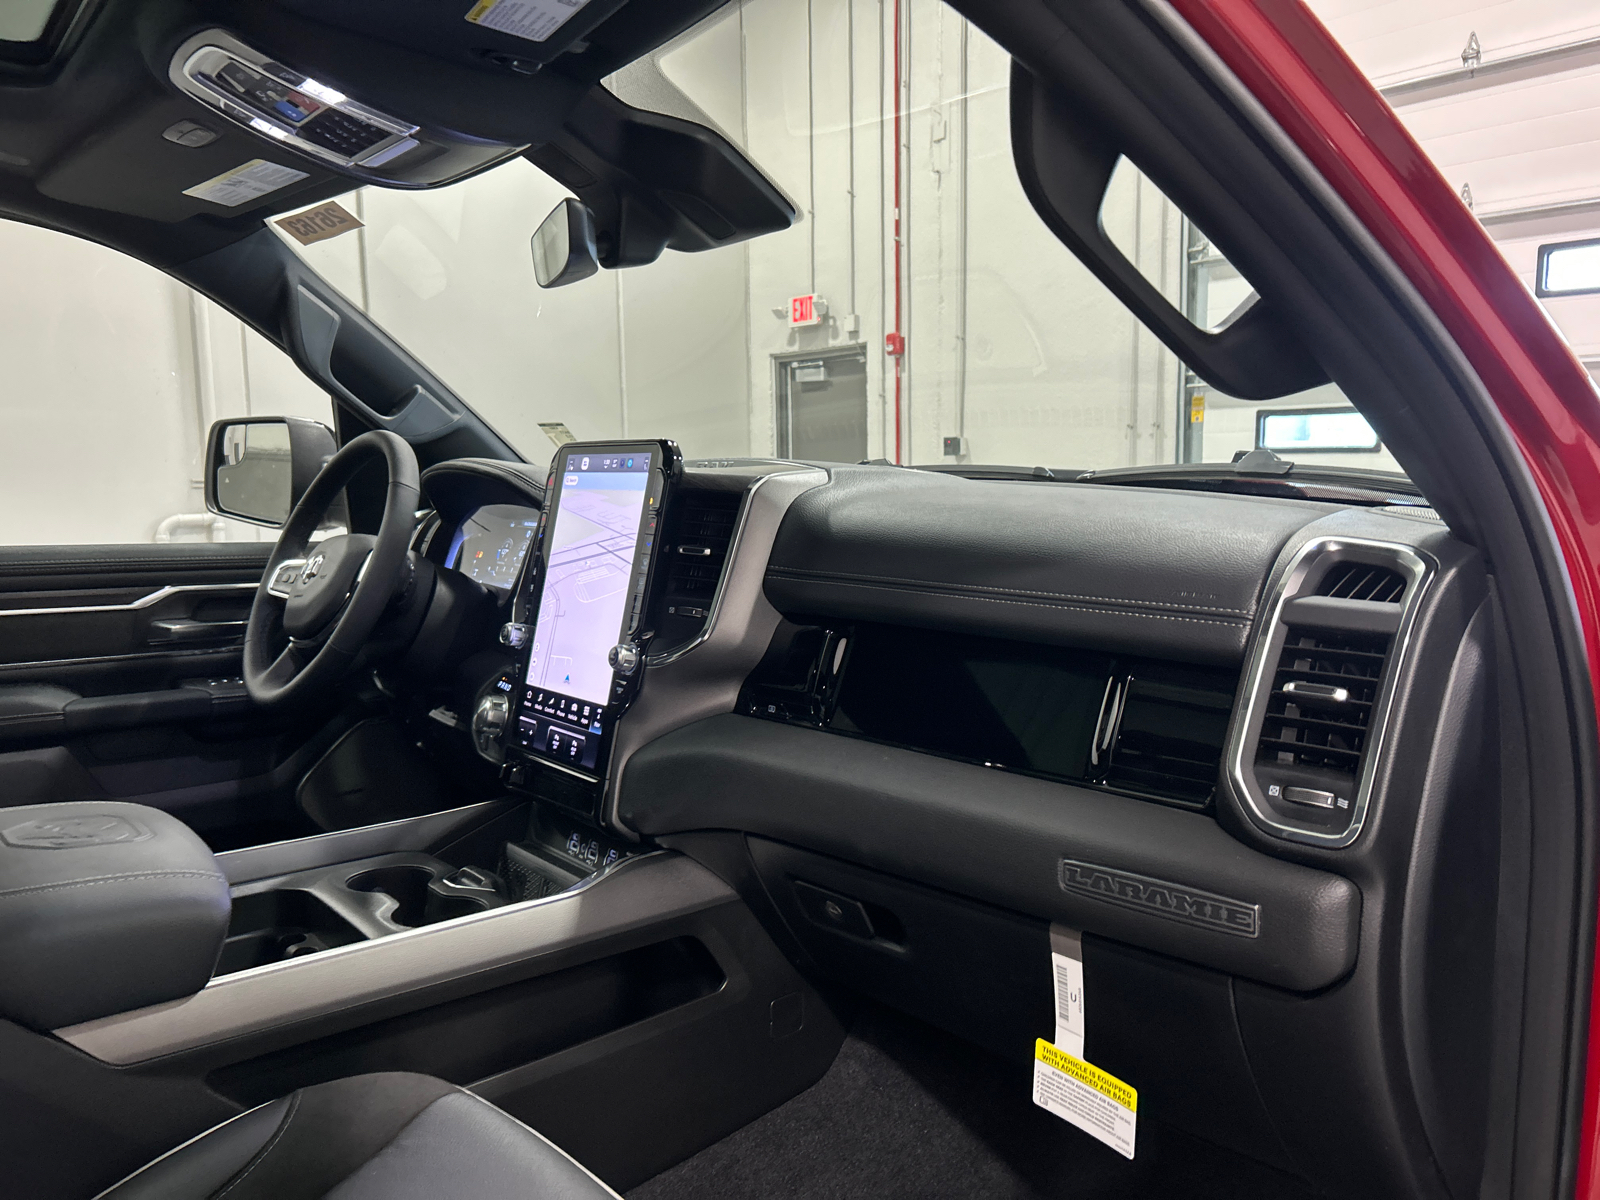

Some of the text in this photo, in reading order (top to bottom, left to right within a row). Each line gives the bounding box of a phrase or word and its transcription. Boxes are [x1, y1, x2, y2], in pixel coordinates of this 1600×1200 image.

[792, 295, 814, 323] EXIT
[1064, 865, 1255, 932] LARAMIE
[1041, 1053, 1131, 1108] WITH ADVANCED AIR BAGS
[1042, 1045, 1132, 1099] THIS VEHICLE IS EQUIPPED
